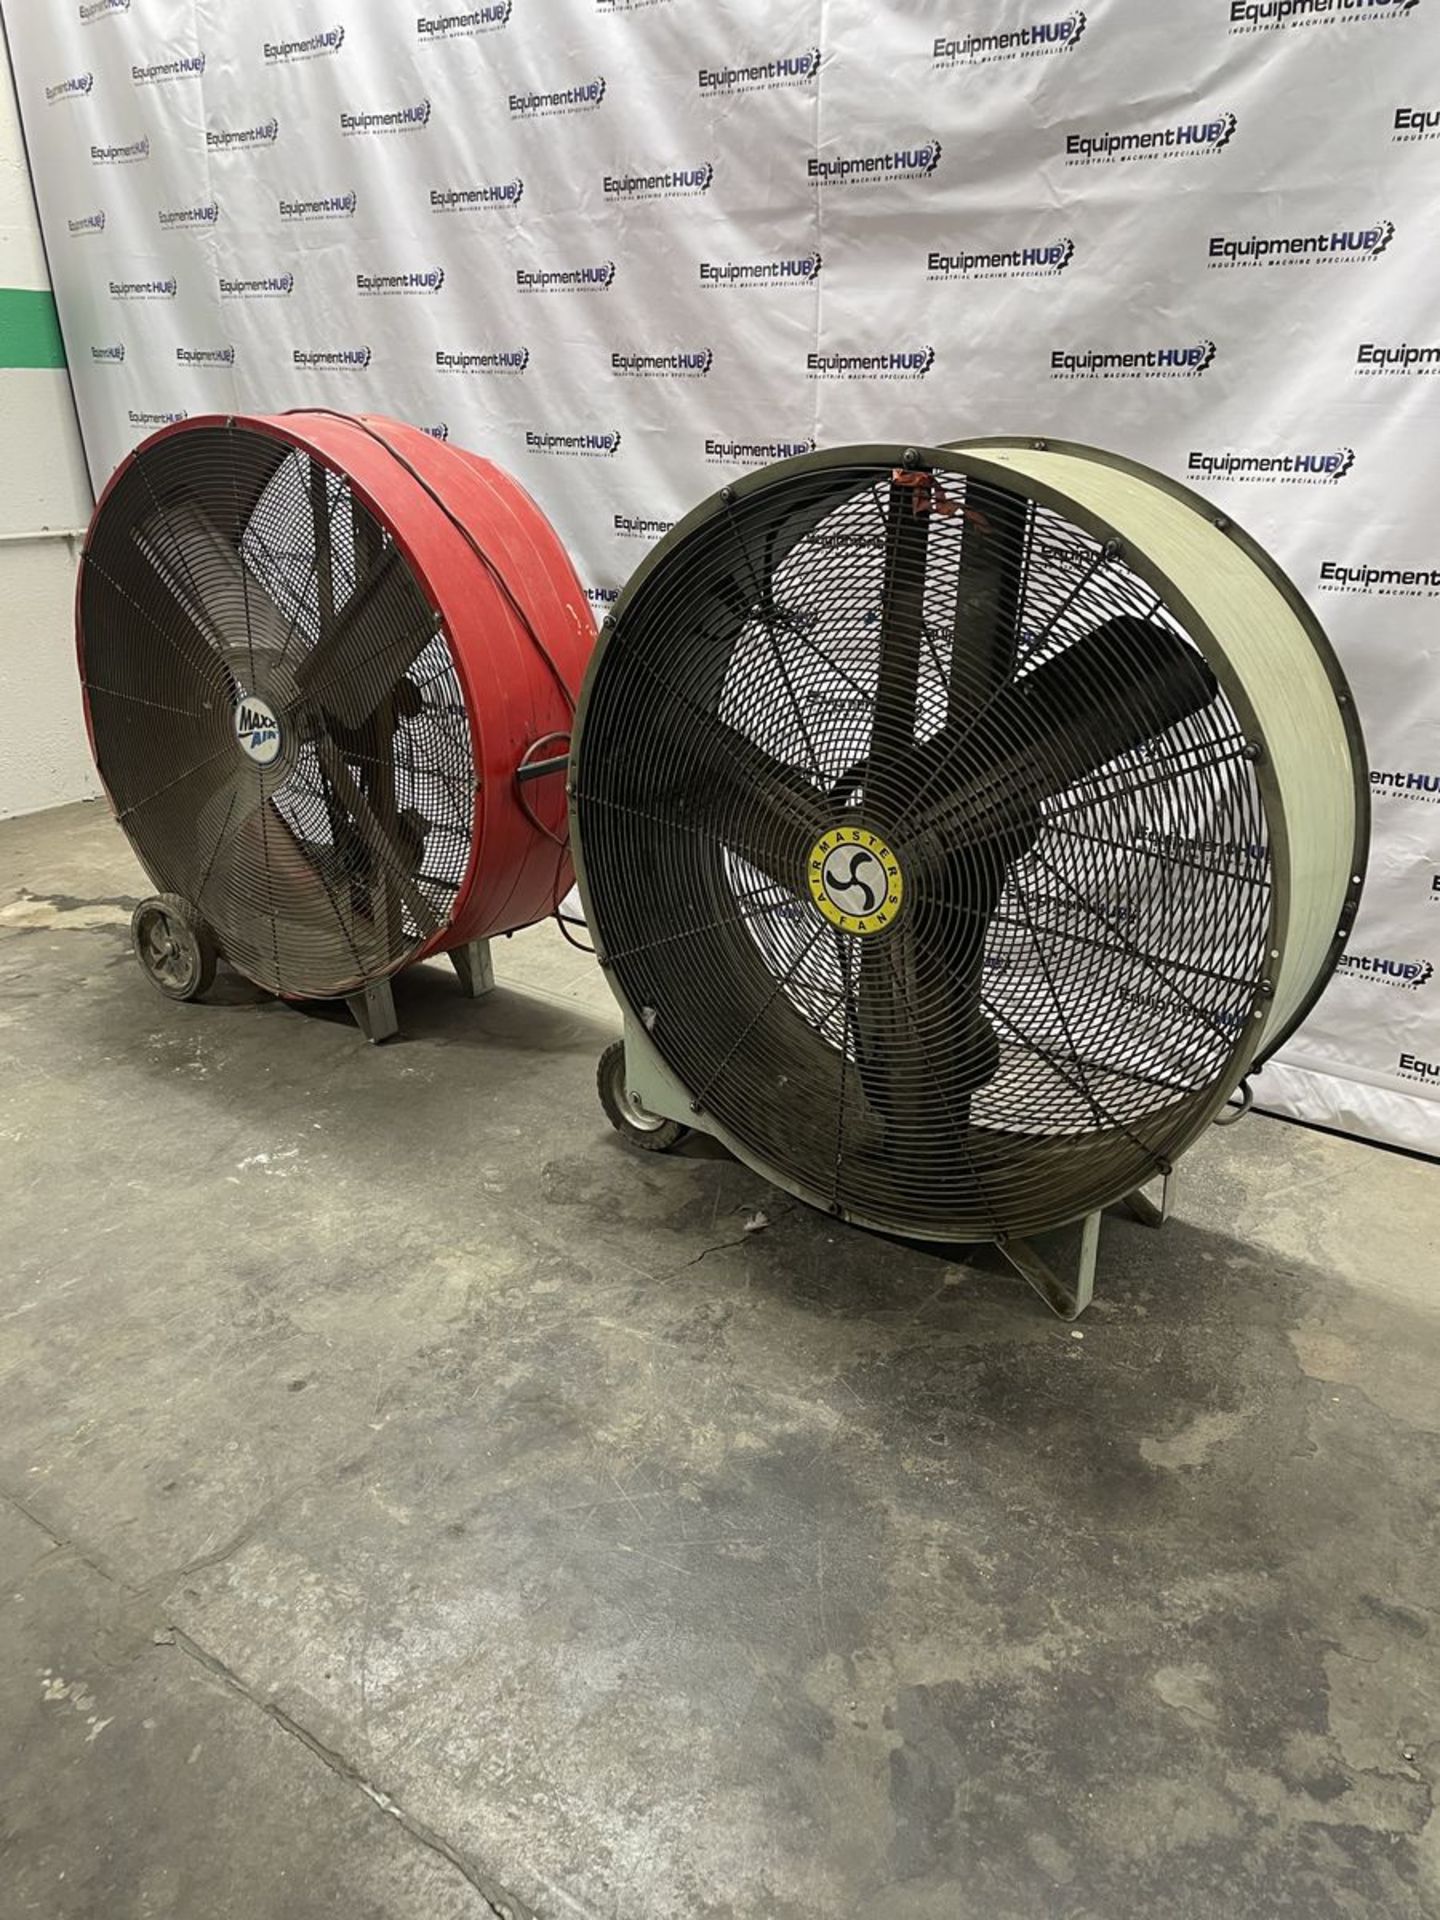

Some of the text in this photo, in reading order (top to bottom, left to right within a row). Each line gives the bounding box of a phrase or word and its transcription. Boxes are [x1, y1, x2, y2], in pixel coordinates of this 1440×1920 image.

[934, 22, 1072, 59] EquipmentHUB
[699, 58, 811, 87] EquipmentHUB
[509, 84, 599, 113] EquipmentHUB
[341, 106, 425, 129] EquipmentHUB
[1066, 124, 1221, 157] EquipmentHUB
[808, 150, 929, 178] EquipmentHUB
[604, 171, 704, 195] EquipmentHUB
[430, 186, 516, 207] EquipmentHUB
[1209, 231, 1380, 261] EquipmentHUB
[700, 260, 812, 282] EquipmentHUB
[928, 247, 1062, 274] EquipmentHUB
[516, 268, 608, 286] EquipmentHUB
[436, 352, 522, 368] EquipmentHUB
[612, 353, 704, 370] EquipmentHUB
[808, 352, 923, 372] EquipmentHUB
[1052, 350, 1202, 372] EquipmentHUB
[526, 432, 613, 450] EquipmentHUB
[1188, 452, 1339, 474] EquipmentHUB
[250, 731, 276, 749] AIR
[812, 832, 898, 930] AIRMASTER FANS
